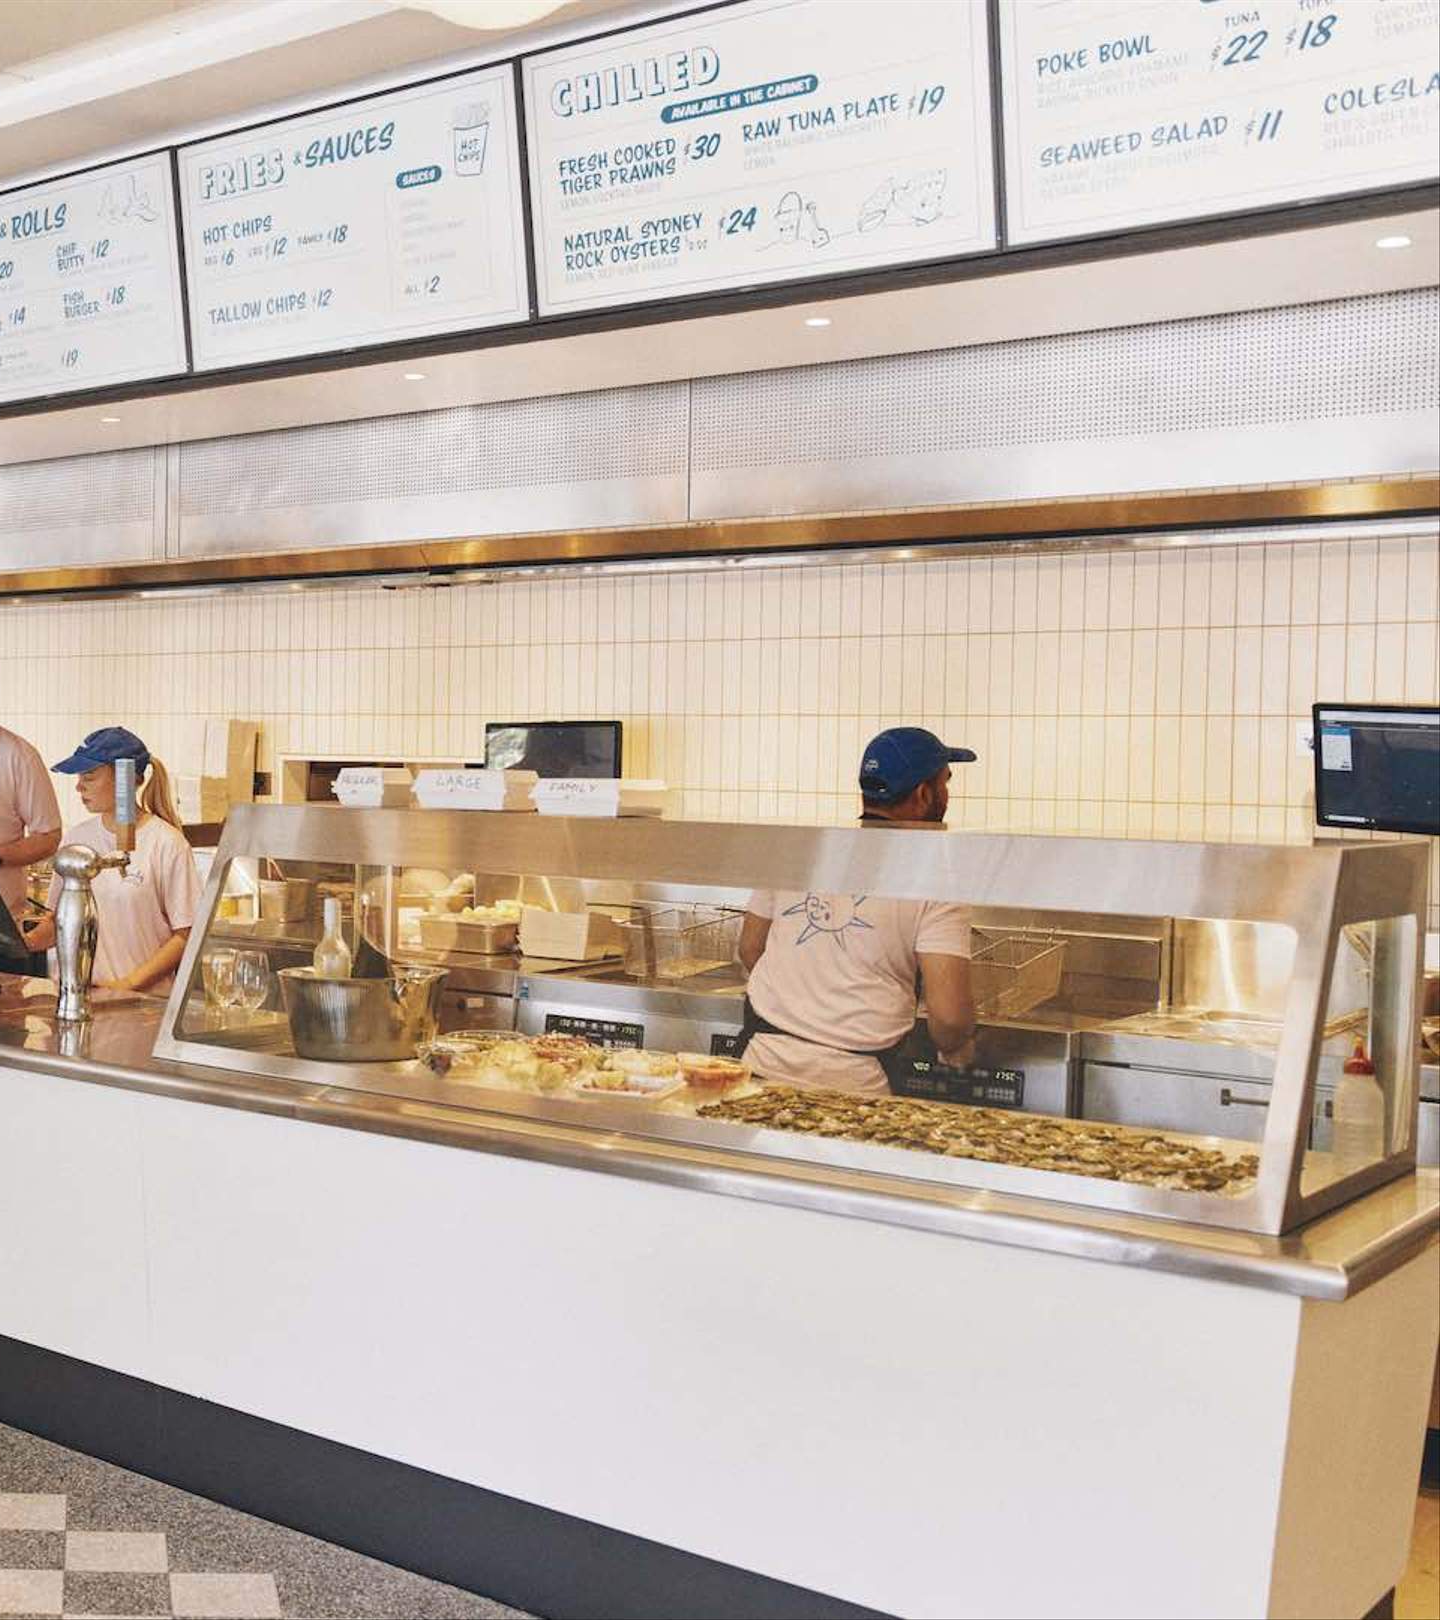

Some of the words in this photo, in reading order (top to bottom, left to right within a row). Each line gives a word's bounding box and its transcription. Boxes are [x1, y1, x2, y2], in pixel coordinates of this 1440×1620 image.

[1224, 11, 1261, 29] TUNA
[1036, 47, 1088, 77] POKE
[1098, 34, 1157, 64] BOWL
[1211, 30, 1269, 69] $22
[1285, 14, 1338, 55] $18
[551, 45, 721, 118] CHILLED
[670, 97, 727, 121] AVAILABLE
[729, 93, 742, 108] IN
[742, 88, 765, 105] THE
[766, 78, 812, 99] CABINET
[742, 116, 781, 144] RAW
[788, 106, 836, 133] TUNA
[842, 92, 901, 121] PLATE
[908, 85, 946, 117] $19
[460, 138, 481, 151] HOT
[558, 151, 609, 178] FRESH
[613, 137, 677, 167] COOKED
[684, 132, 721, 162] $30
[1039, 132, 1142, 168] SEAWEED
[1151, 115, 1228, 148] SALAD
[1244, 109, 1283, 145] $11
[198, 148, 285, 200] FRIES
[304, 121, 396, 169] SAUCES
[403, 169, 436, 186] SAUCES
[559, 172, 603, 196] TIGER
[609, 156, 677, 187] PRAWNS
[0, 222, 8, 239] &
[11, 203, 68, 240] ROLLS
[203, 224, 228, 246] HOT
[232, 215, 273, 240] CHIPS
[563, 224, 633, 253] NATURAL
[640, 211, 704, 240] SYDNEY
[719, 206, 757, 236] $24
[57, 254, 86, 272] BUTTY
[565, 248, 604, 272] ROCK
[610, 235, 681, 264] OYSTERS
[63, 290, 85, 307] FISH
[64, 301, 101, 319] BURGER
[208, 299, 263, 326] TALLOW
[266, 291, 307, 315] CHIPS
[435, 775, 482, 790] LARGE
[548, 782, 597, 794] FAMILY
